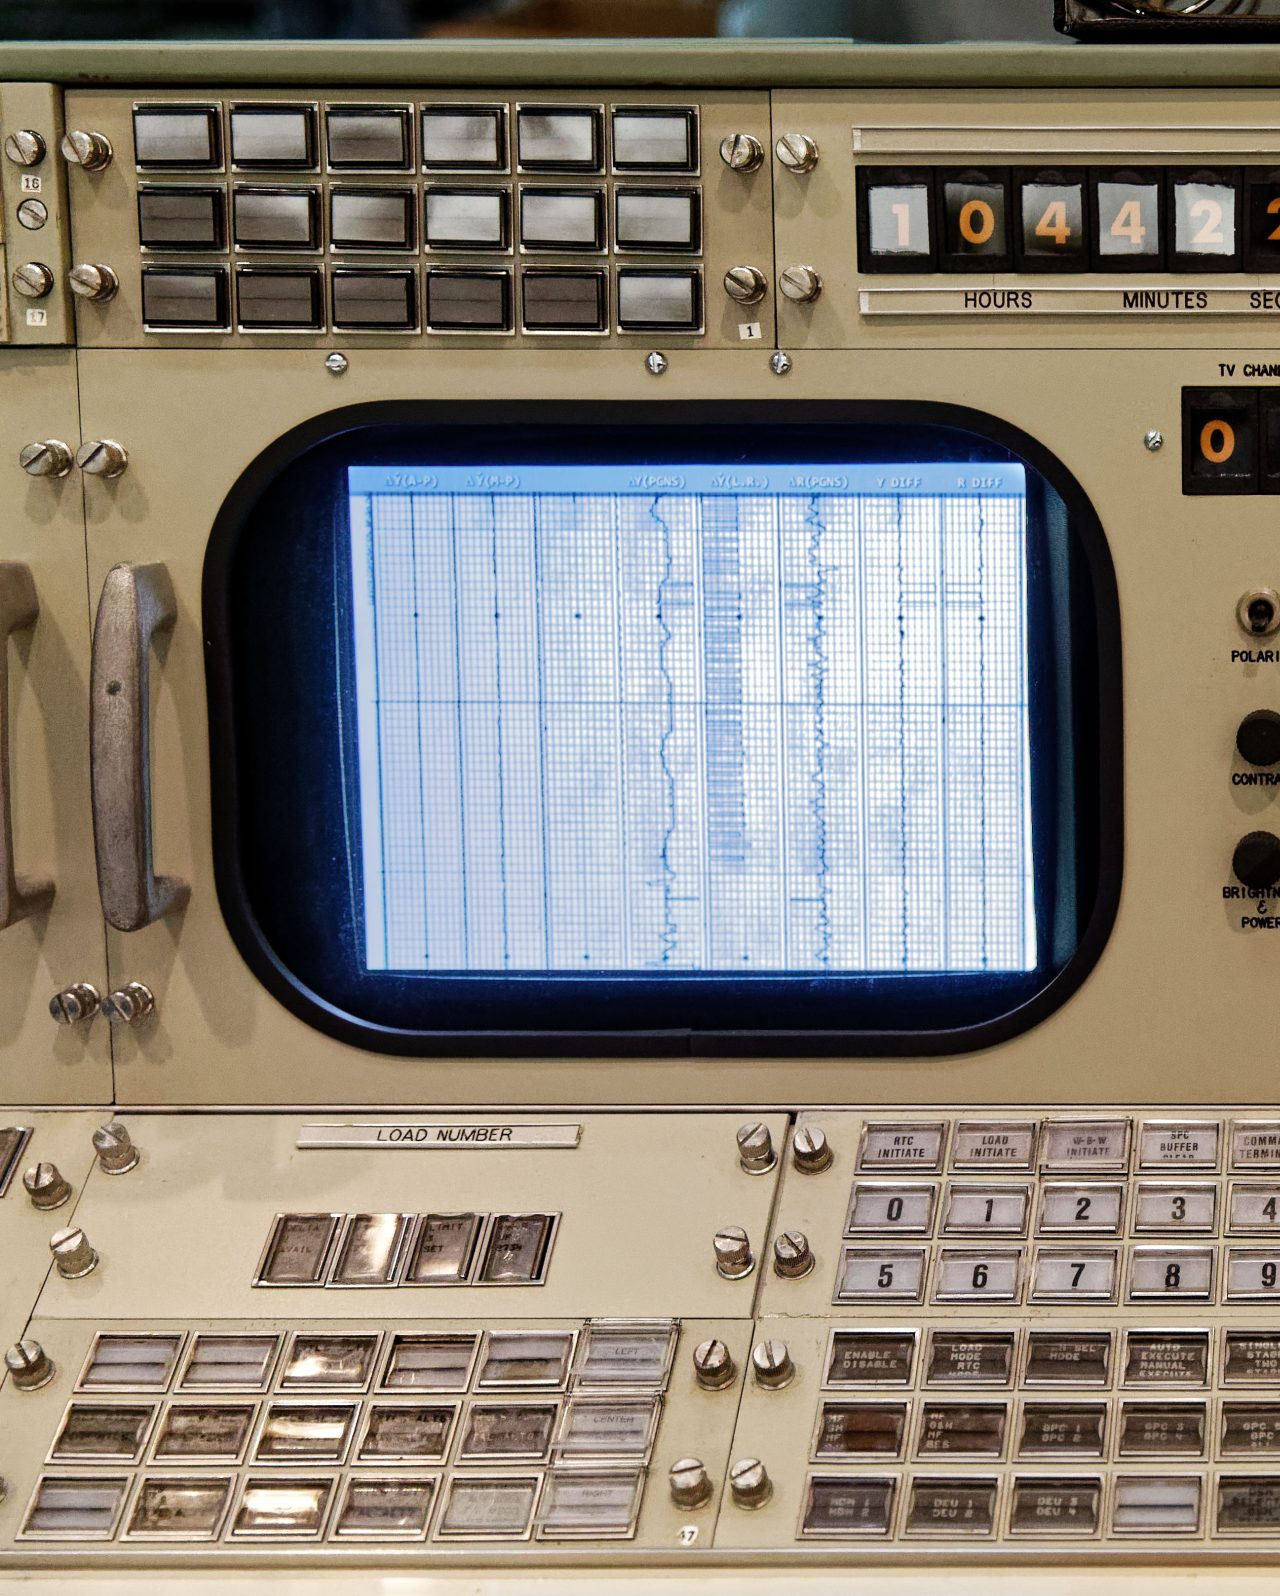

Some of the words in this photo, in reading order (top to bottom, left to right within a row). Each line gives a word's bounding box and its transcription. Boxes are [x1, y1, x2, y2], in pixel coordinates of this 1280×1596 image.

[25, 178, 40, 190] 16
[964, 291, 1033, 309] HOURS
[1123, 291, 1208, 309] MINUTES
[746, 324, 755, 338] 1
[1218, 364, 1236, 377] TV
[889, 477, 921, 488] DIFF
[958, 477, 966, 488] R
[970, 477, 1002, 488] DIFF
[376, 1128, 428, 1142] LOAD
[436, 1128, 513, 1142] NUMBER
[894, 1136, 914, 1145] RTC
[981, 1136, 1009, 1145] LOAD
[1066, 1147, 1110, 1157] INITIATE
[1160, 1142, 1198, 1151] BUFFER
[877, 1148, 925, 1158] INITIATE
[970, 1148, 1017, 1158] INITIATE
[887, 1197, 904, 1221] 0
[985, 1199, 994, 1222] 1
[1074, 1197, 1091, 1220] 2
[1171, 1197, 1186, 1220] 3
[1262, 1197, 1277, 1220] 4
[877, 1264, 894, 1288] 5
[972, 1264, 988, 1288] 6
[1070, 1263, 1086, 1287] 7
[1165, 1263, 1181, 1287] 8
[1261, 1262, 1277, 1287] 9
[615, 1347, 638, 1355] LEFT
[1150, 1343, 1181, 1351] AUTO
[844, 1351, 891, 1359] ENABLE
[951, 1353, 981, 1361] MODE
[1050, 1352, 1080, 1361] MODE
[1141, 1352, 1195, 1361] EXECUTE
[843, 1360, 897, 1368] DISABLE
[957, 1362, 980, 1370] RTC
[927, 1431, 944, 1439] MF
